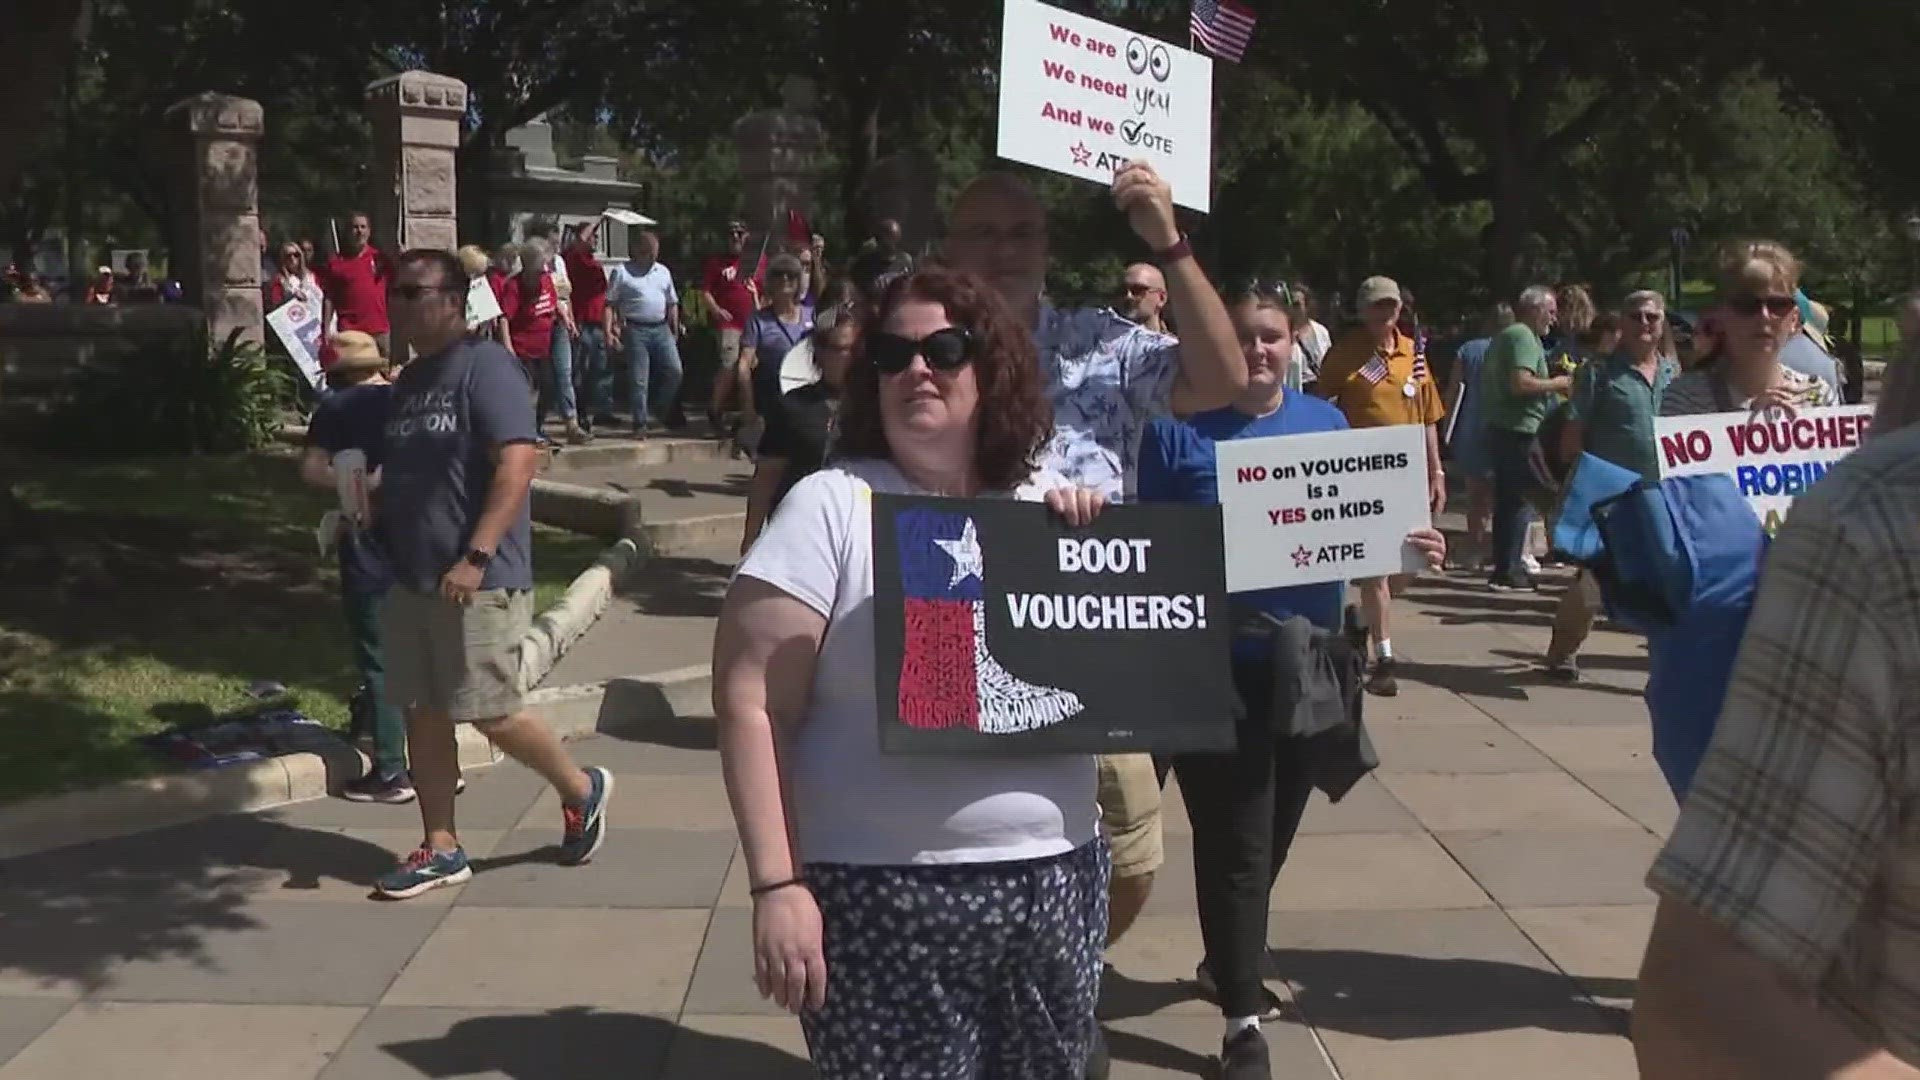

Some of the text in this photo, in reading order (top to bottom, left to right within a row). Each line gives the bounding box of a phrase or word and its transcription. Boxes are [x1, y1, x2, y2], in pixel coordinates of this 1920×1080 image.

[1049, 23, 1117, 58] We are
[1043, 59, 1076, 83] We
[1081, 73, 1128, 99] need
[1041, 101, 1082, 126] And
[1087, 115, 1115, 135] we
[1661, 430, 1712, 468] NO
[1237, 453, 1408, 483] NO on VOUCHERS
[1307, 484, 1339, 499] is a
[1268, 500, 1384, 525] YES on KIDS
[1057, 538, 1151, 573] BOOT
[1316, 543, 1365, 563] ATPE
[1006, 593, 1206, 629] VOUCHERS!
